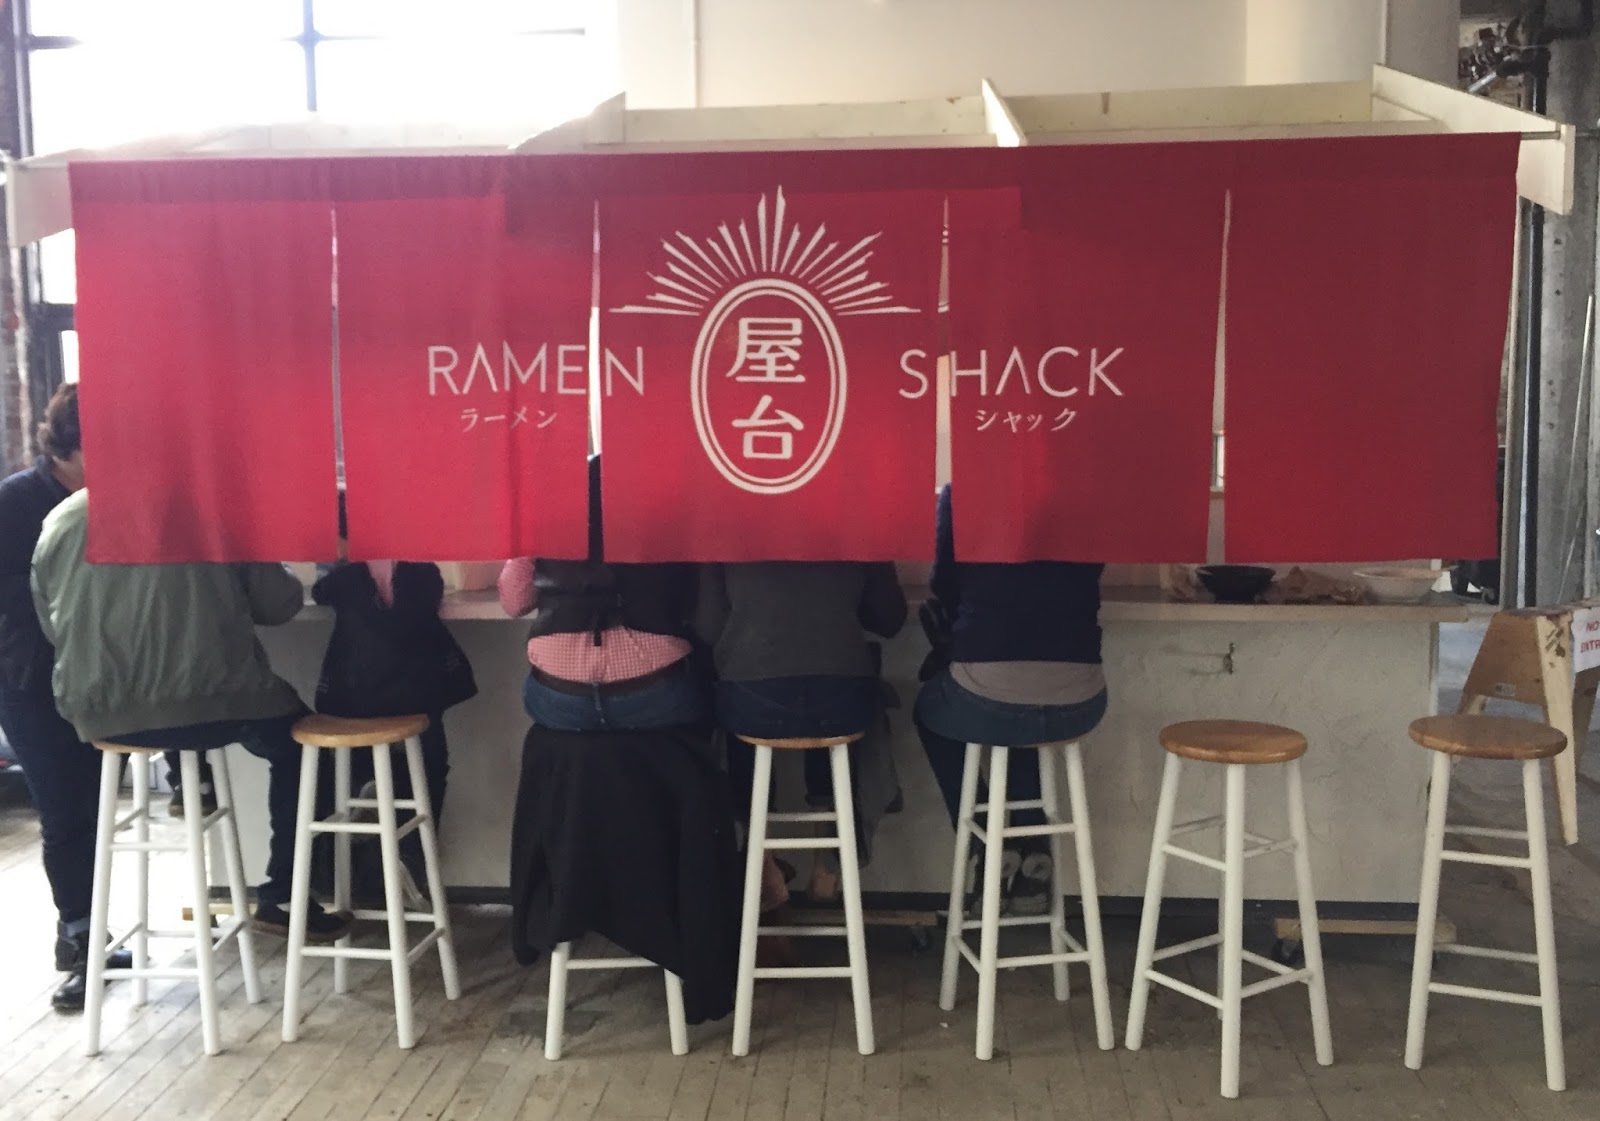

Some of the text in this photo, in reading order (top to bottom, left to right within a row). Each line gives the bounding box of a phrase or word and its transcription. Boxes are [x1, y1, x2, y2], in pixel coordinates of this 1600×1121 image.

[428, 341, 1125, 399] RAMEN SHACK
[725, 317, 806, 460] 屋台
[460, 406, 557, 432] ラーメン
[975, 407, 1077, 433] シャック
